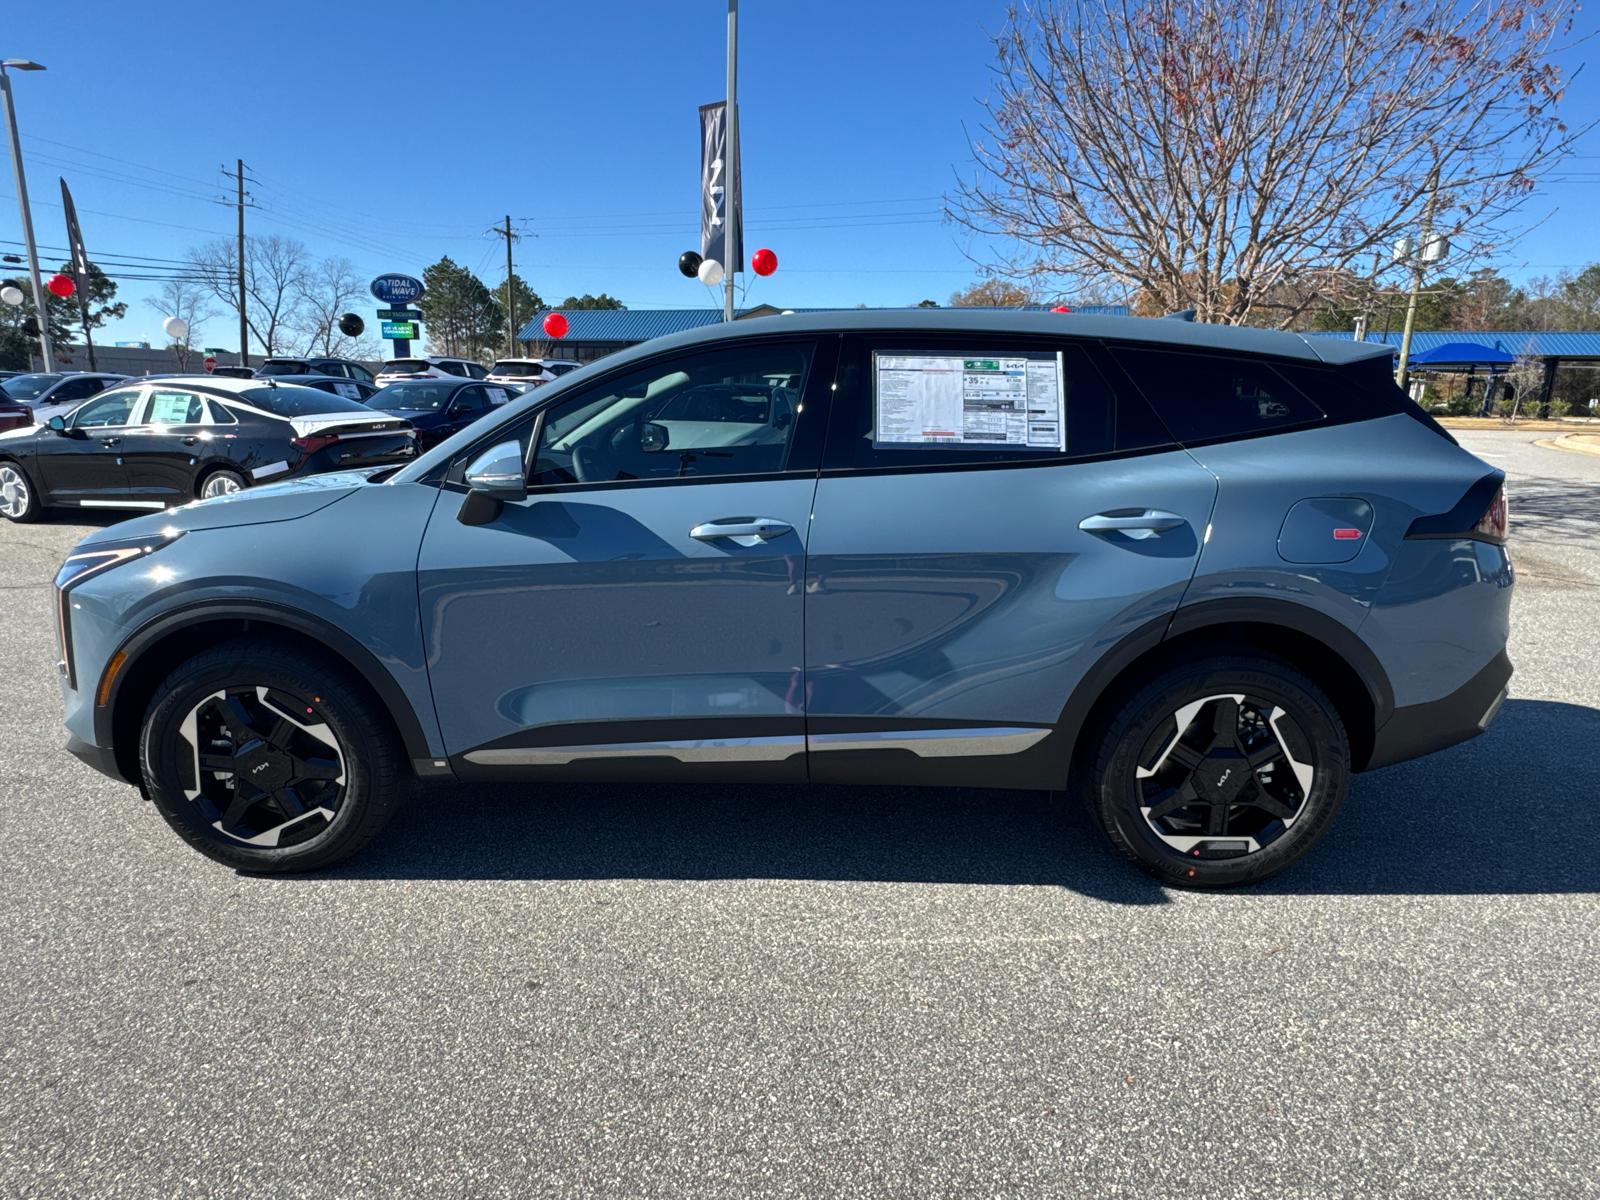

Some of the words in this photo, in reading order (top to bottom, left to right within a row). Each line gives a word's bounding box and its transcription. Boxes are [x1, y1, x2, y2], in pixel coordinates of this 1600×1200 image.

[387, 279, 411, 287] TIDAL
[391, 287, 416, 295] WAVE
[968, 376, 979, 385] 35
[252, 762, 270, 774] KIA
[1216, 768, 1232, 787] KIA
